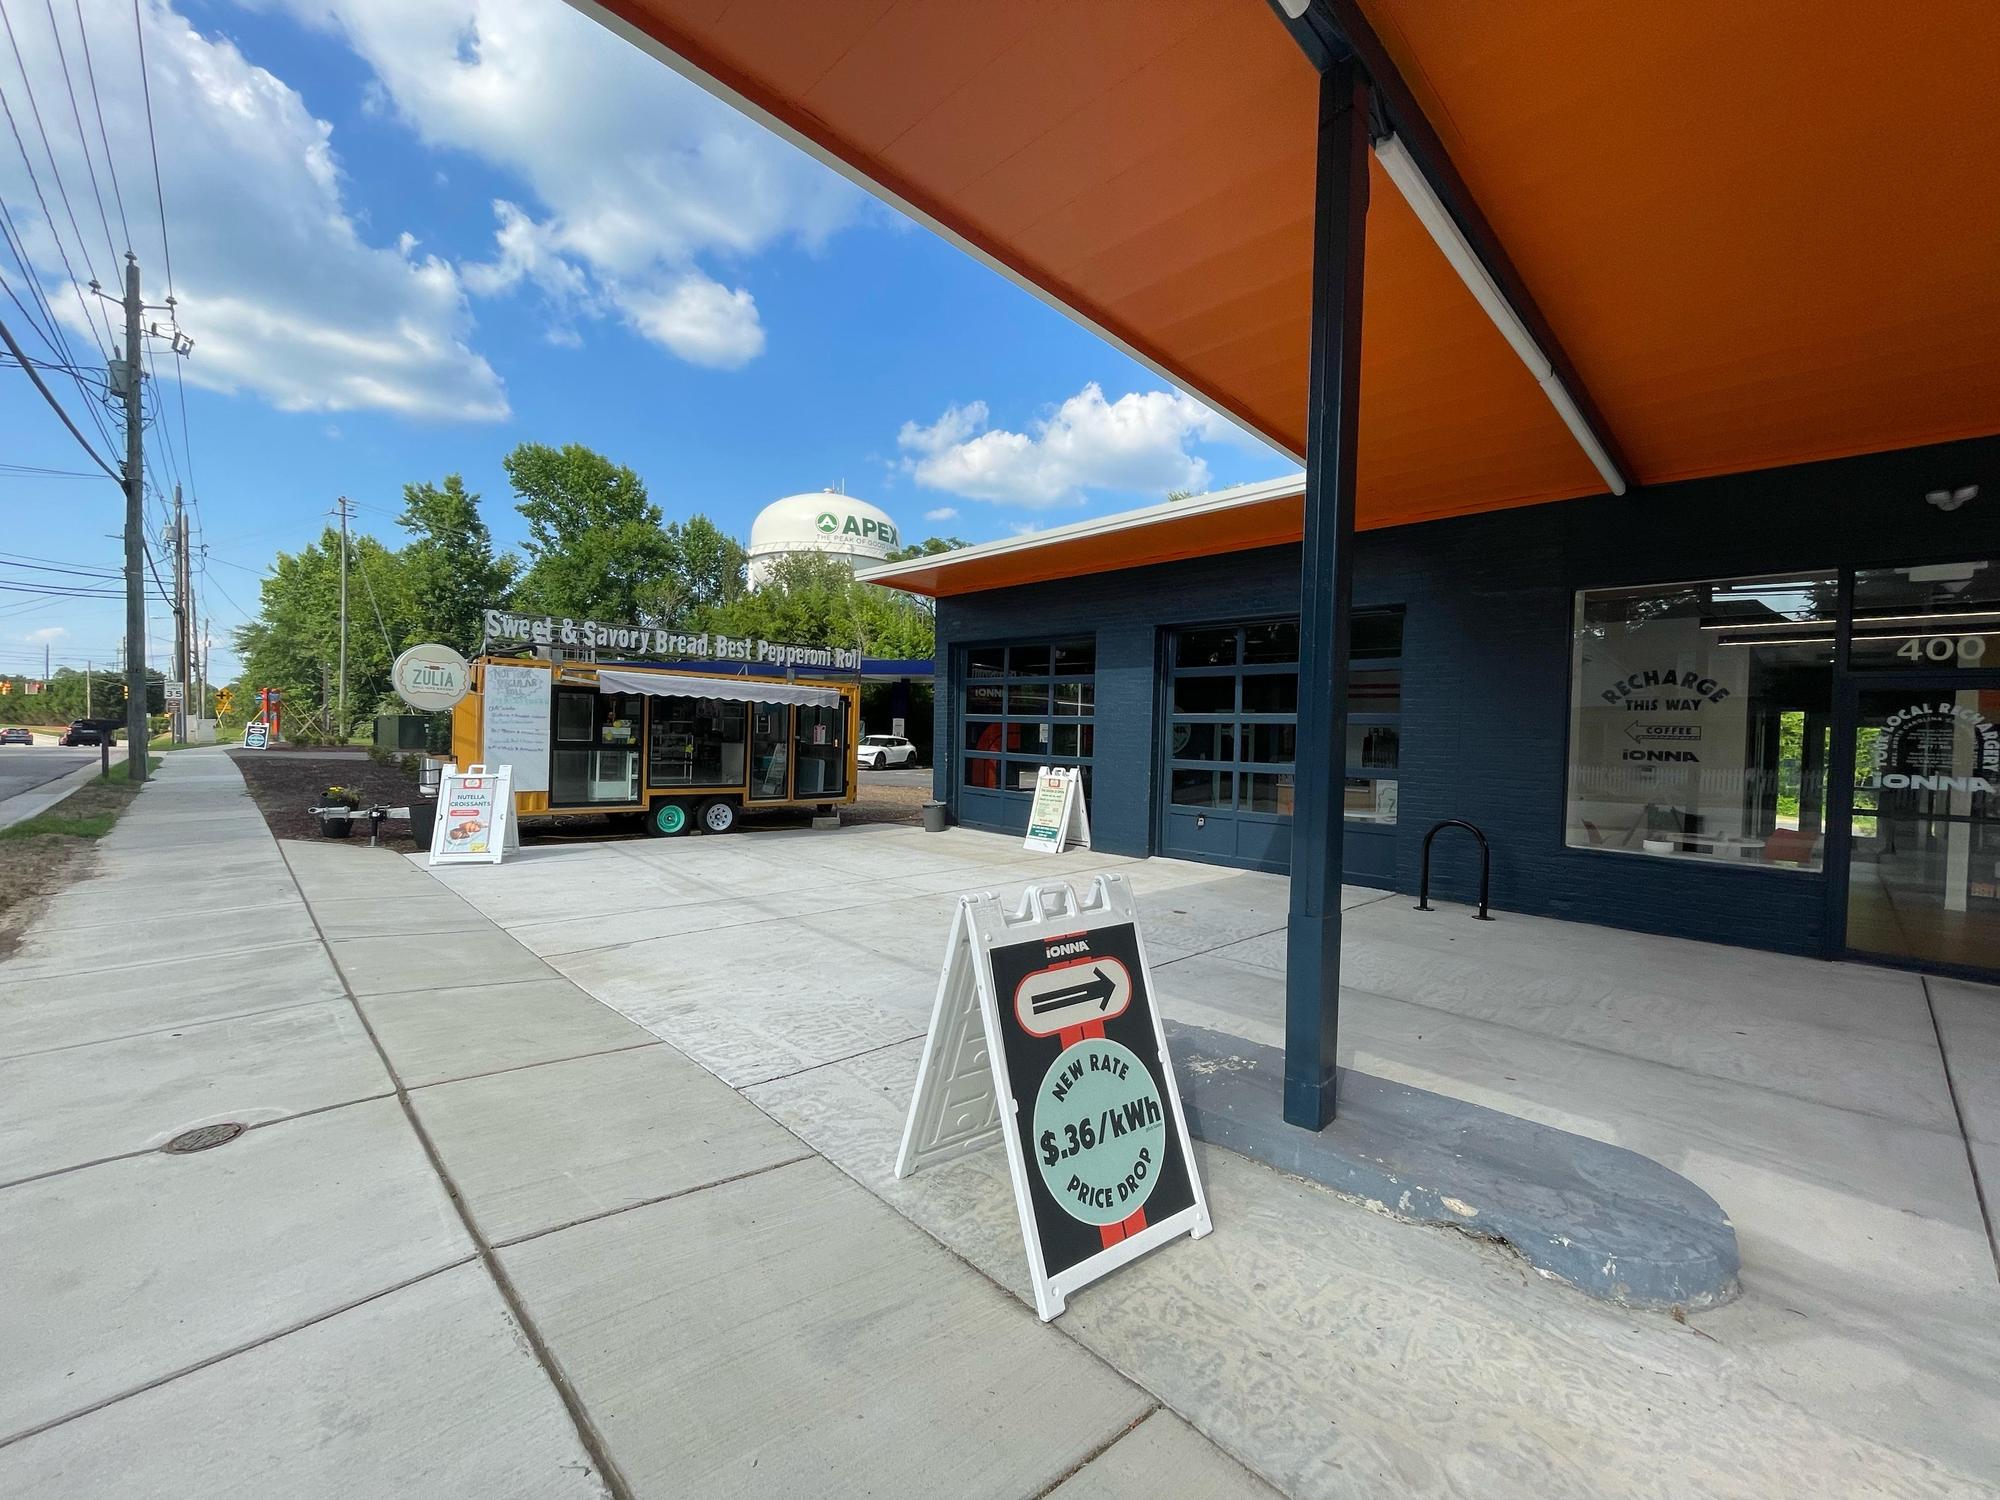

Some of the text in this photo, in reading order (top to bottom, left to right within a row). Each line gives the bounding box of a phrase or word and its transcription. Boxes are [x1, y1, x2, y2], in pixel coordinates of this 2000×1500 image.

[833, 535, 854, 543] PEAK
[842, 515, 899, 547] APEX
[486, 609, 553, 643] Sweet
[560, 618, 578, 645] &
[583, 621, 650, 655] Savory
[716, 635, 752, 660] Best
[757, 640, 832, 667] Pepperoni
[834, 646, 862, 670] Roll
[1896, 635, 1986, 661] 400
[412, 669, 454, 688] ZULIA
[975, 687, 1004, 698] IONN
[1601, 669, 1730, 704] RECHARGE
[166, 690, 183, 698] 35
[1625, 699, 1702, 711] THIS WAY
[1646, 727, 1692, 735] COFFEE
[1881, 703, 1933, 732] LOCAL
[1938, 703, 2000, 772] RECHARGERY
[1051, 1053, 1130, 1103] NEW RATE
[1040, 1096, 1161, 1167] $.36/kWh
[1066, 1147, 1152, 1209] PRICE DROP
